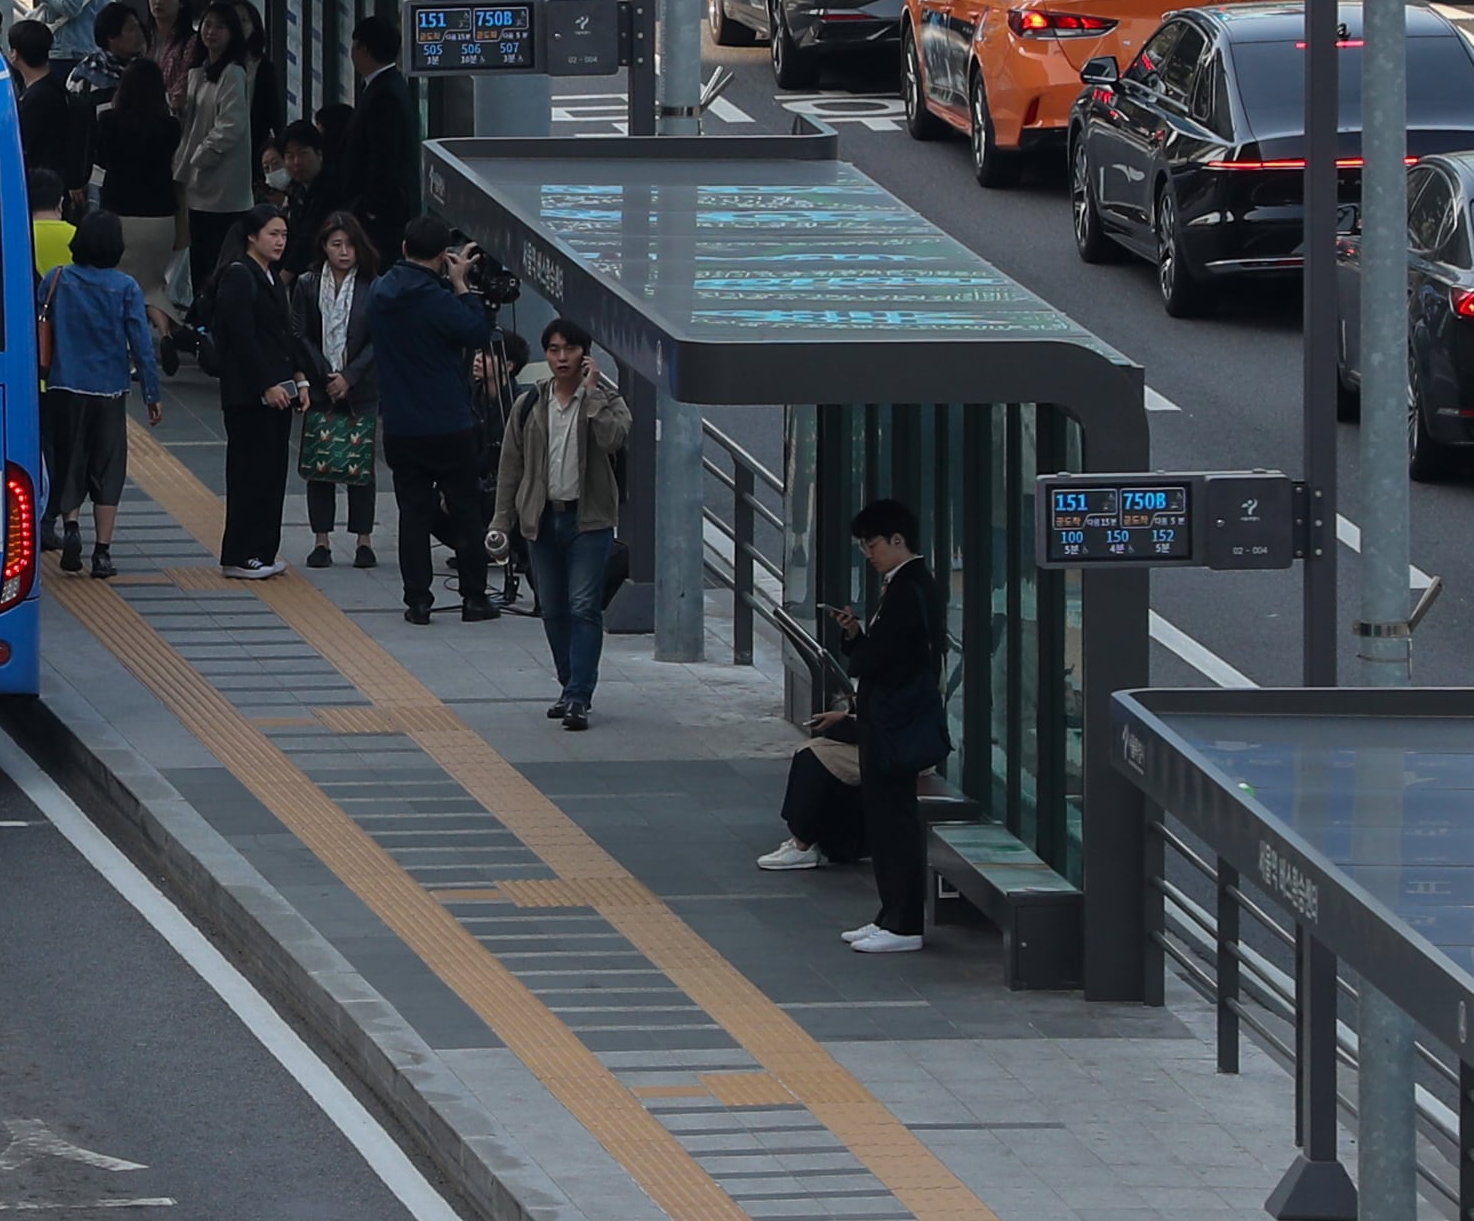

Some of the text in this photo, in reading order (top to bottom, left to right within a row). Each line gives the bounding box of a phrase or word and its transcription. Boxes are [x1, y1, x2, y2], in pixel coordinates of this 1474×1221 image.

[419, 12, 446, 28] 151
[476, 11, 513, 27] 750B
[423, 44, 443, 55] 505
[461, 43, 481, 55] 506
[500, 43, 520, 54] 507
[1055, 493, 1088, 511] 151
[1123, 491, 1167, 510] 750B
[1061, 531, 1083, 543] 100
[1106, 530, 1129, 543] 150
[1152, 529, 1175, 542] 152
[1064, 545, 1080, 554] 5분
[1109, 544, 1125, 553] 4분
[1155, 544, 1170, 553] 5분
